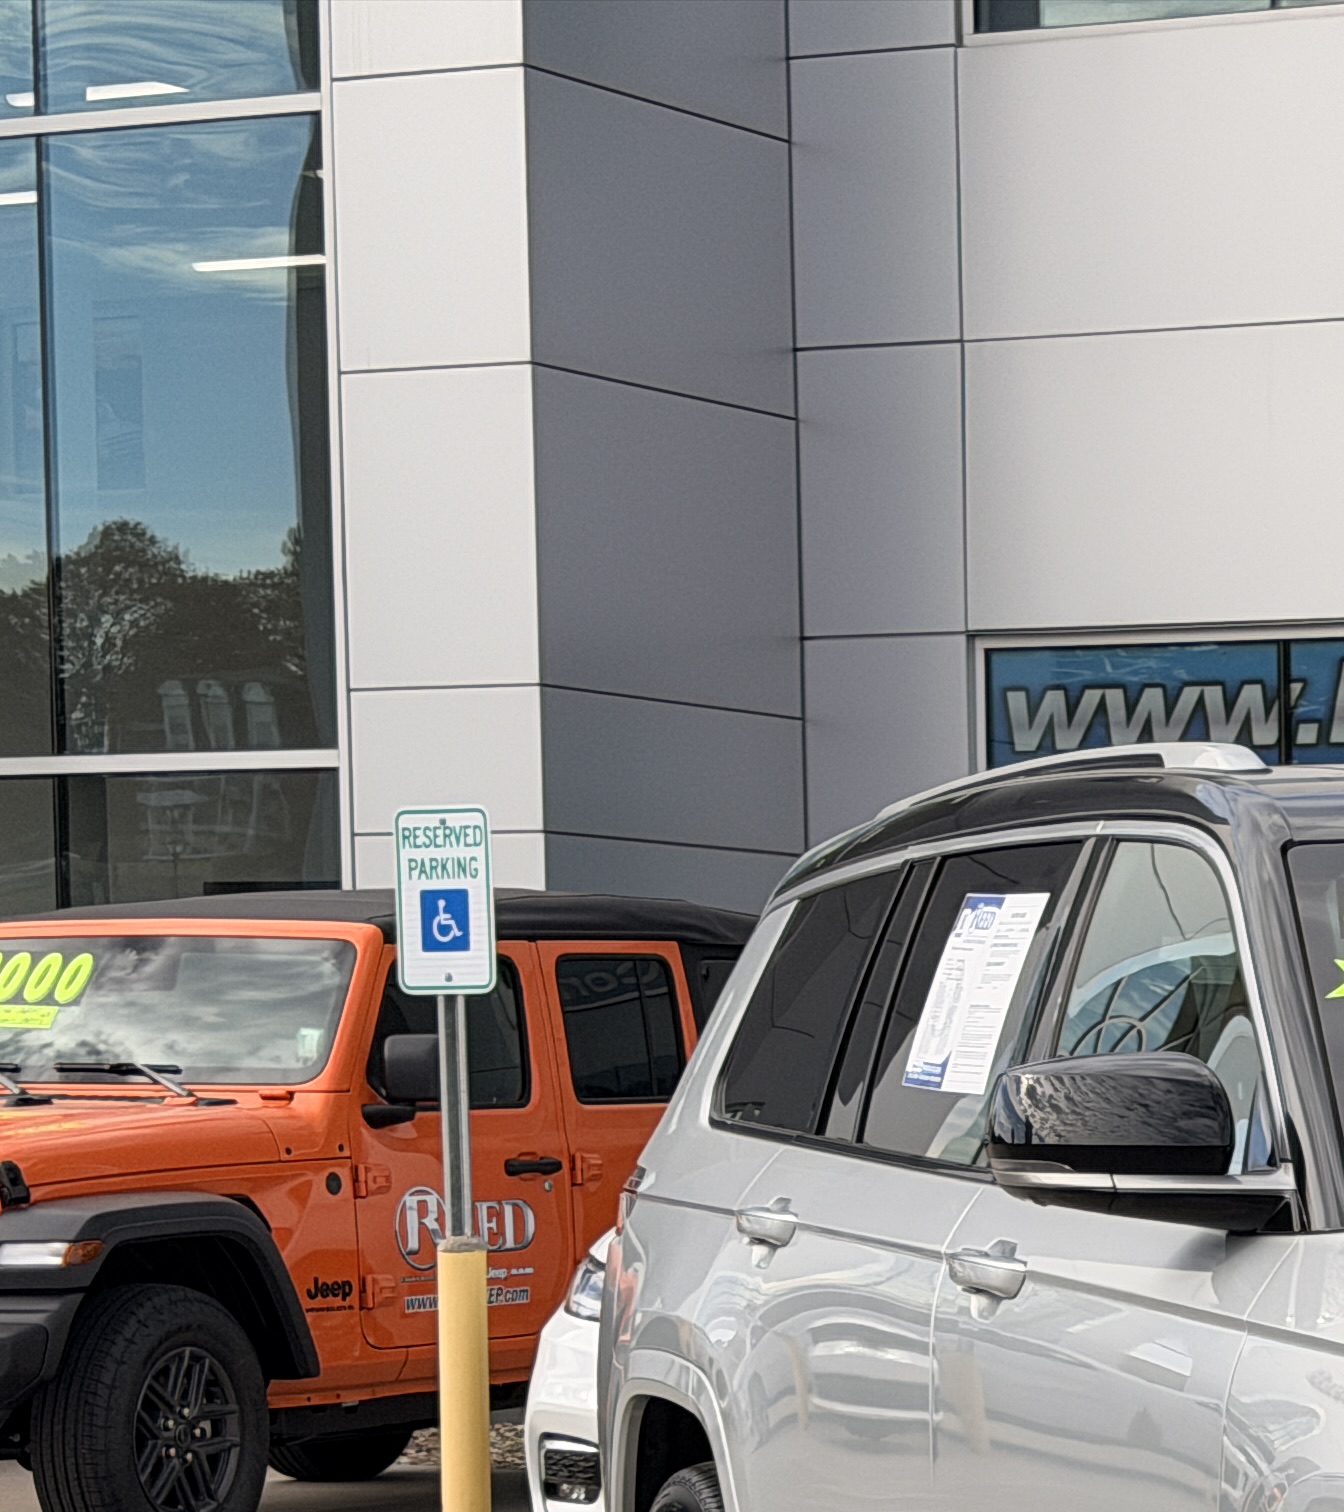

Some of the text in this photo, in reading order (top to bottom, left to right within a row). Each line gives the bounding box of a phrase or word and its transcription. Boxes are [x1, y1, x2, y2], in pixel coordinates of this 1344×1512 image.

[402, 825, 483, 849] RESERVED
[407, 856, 479, 880] PARKING
[403, 1194, 536, 1256] RED
[306, 1276, 353, 1301] Jeep
